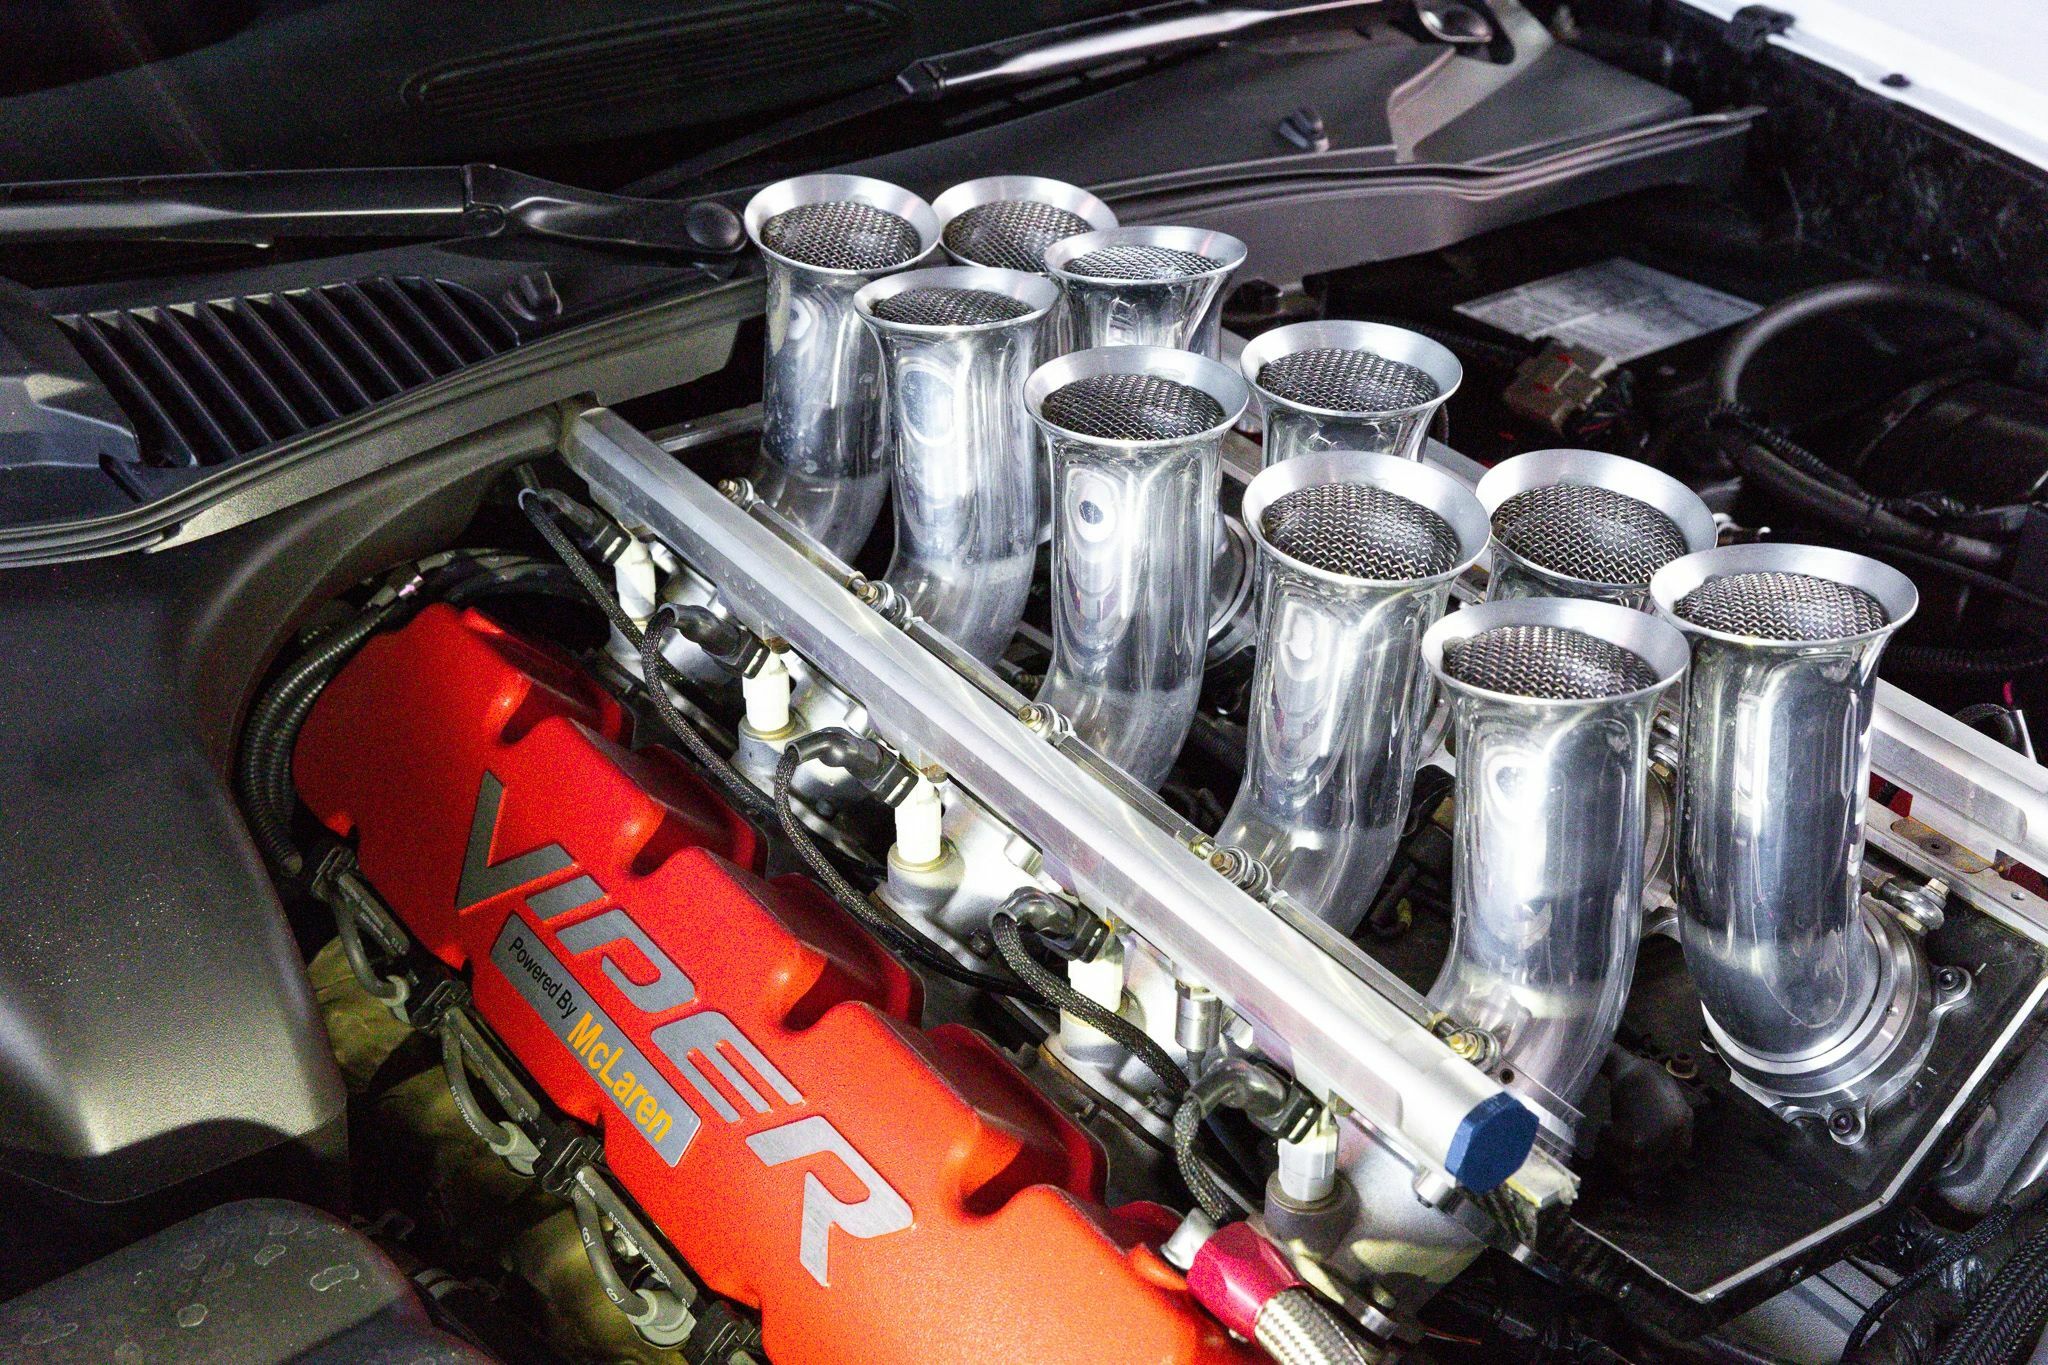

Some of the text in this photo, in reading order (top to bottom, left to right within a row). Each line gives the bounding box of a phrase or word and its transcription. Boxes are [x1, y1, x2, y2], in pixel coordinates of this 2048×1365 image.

[455, 770, 916, 1287] VIPER
[508, 936, 674, 1143] Powered By McLaren
